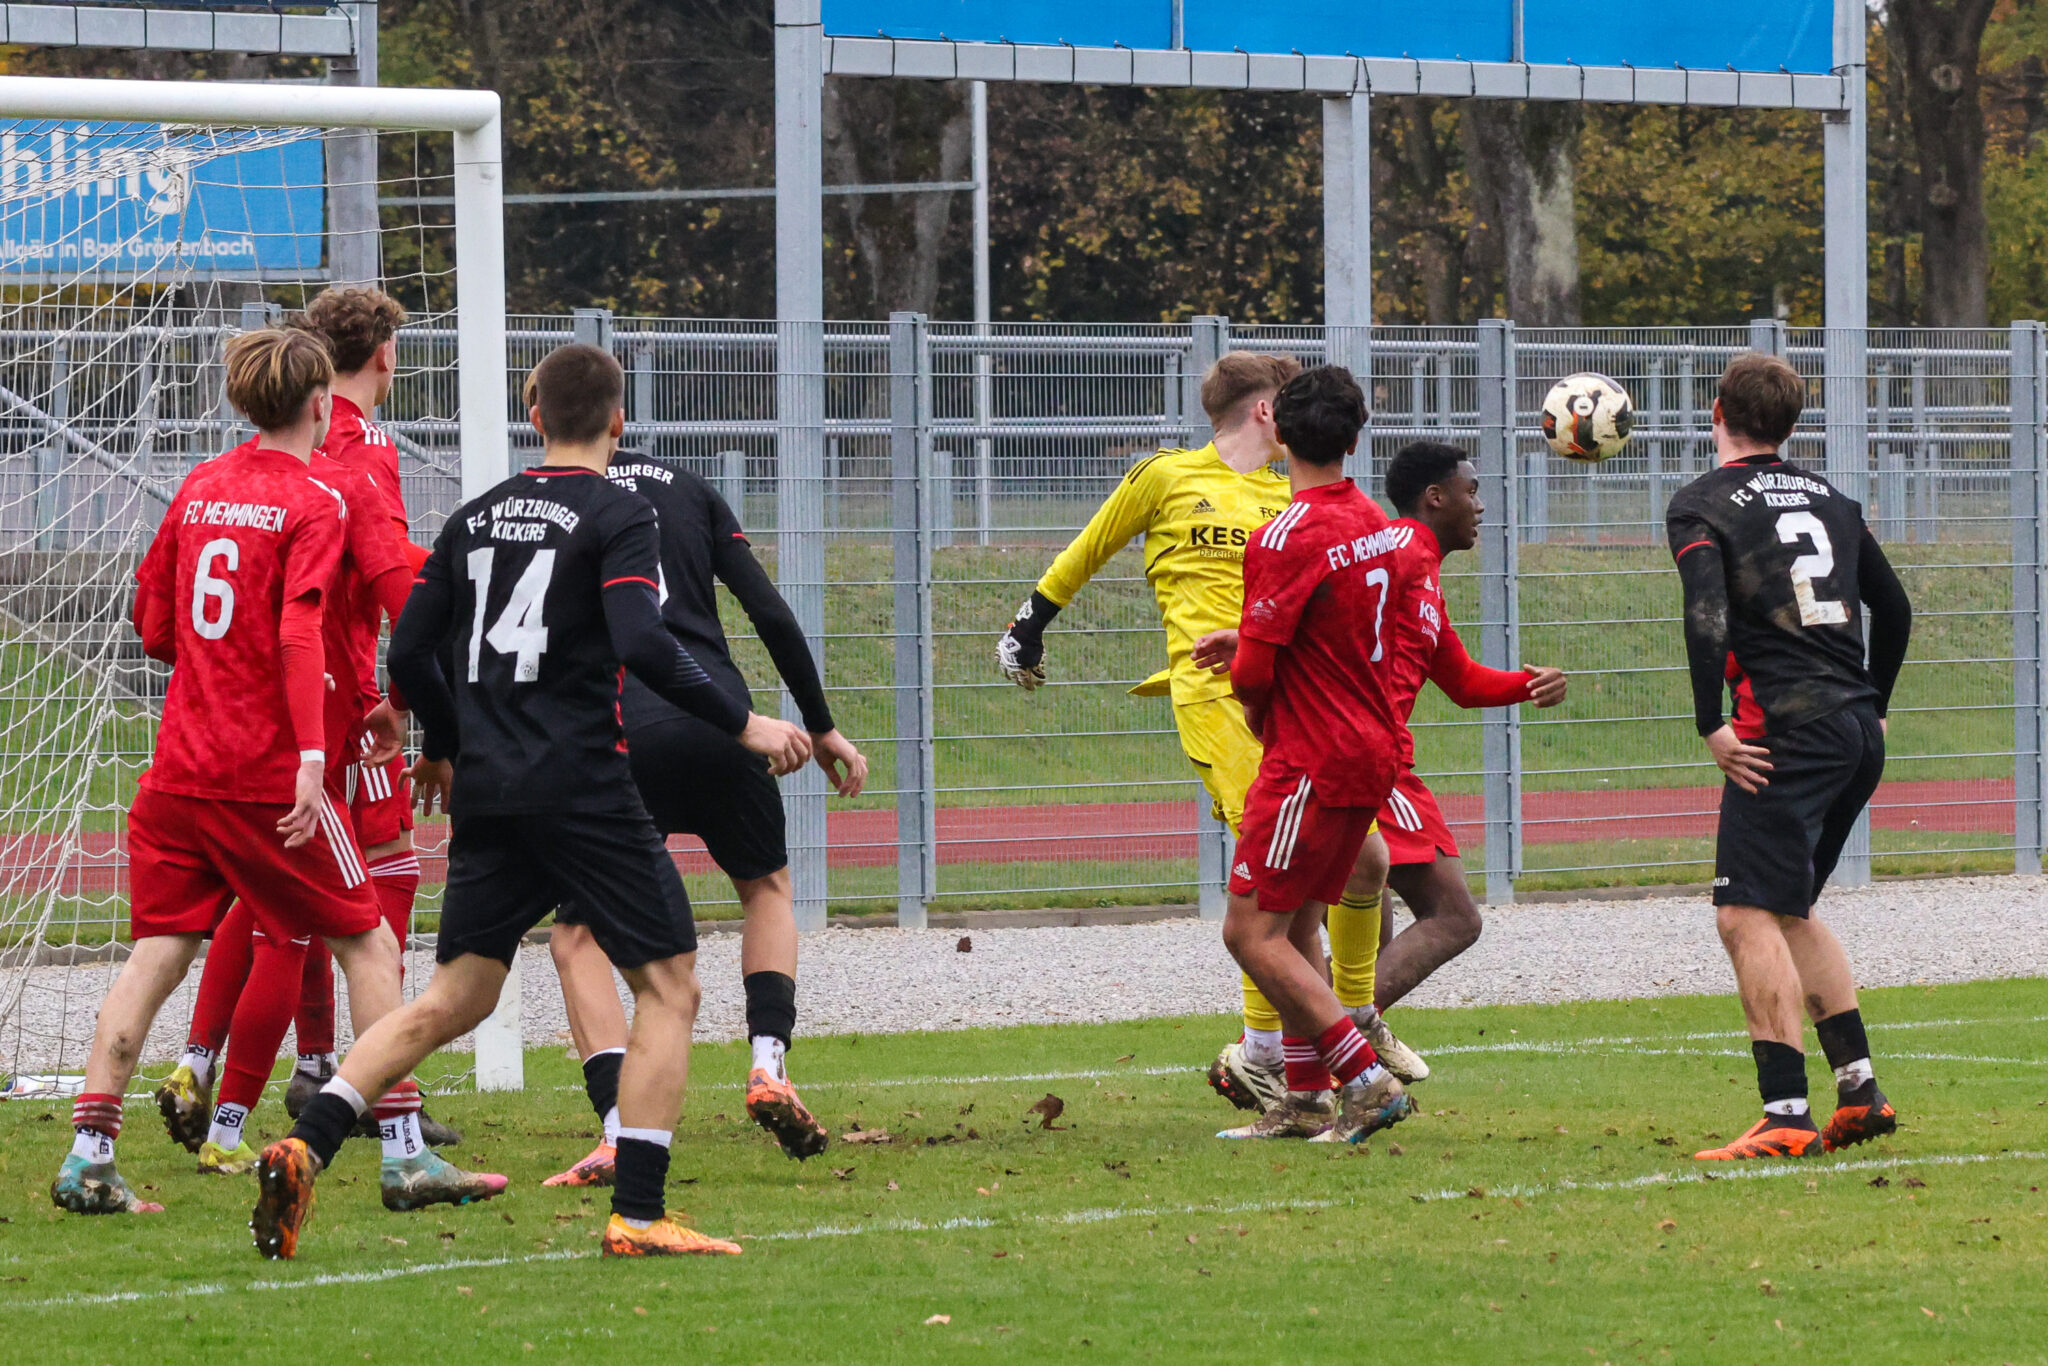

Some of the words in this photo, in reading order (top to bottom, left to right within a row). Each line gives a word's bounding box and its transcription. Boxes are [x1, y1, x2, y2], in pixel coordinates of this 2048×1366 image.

[84, 238, 122, 258] Bad
[604, 463, 674, 485] BURGER
[1730, 489, 1753, 507] FC
[1746, 471, 1830, 497] WÜRZBURGER
[1763, 491, 1810, 507] KICKERS
[182, 500, 204, 526] FC
[201, 501, 287, 533] MEMMINGEN
[466, 511, 487, 535] FC
[491, 496, 580, 534] WÜRZBURGER
[490, 521, 547, 541] KICKERS
[1191, 526, 1251, 546] KES
[1326, 544, 1351, 571] FC
[1775, 511, 1849, 626] 2
[192, 538, 239, 640] 6
[467, 547, 557, 683] 14
[1366, 568, 1389, 662] 7
[215, 1106, 242, 1126] FS
